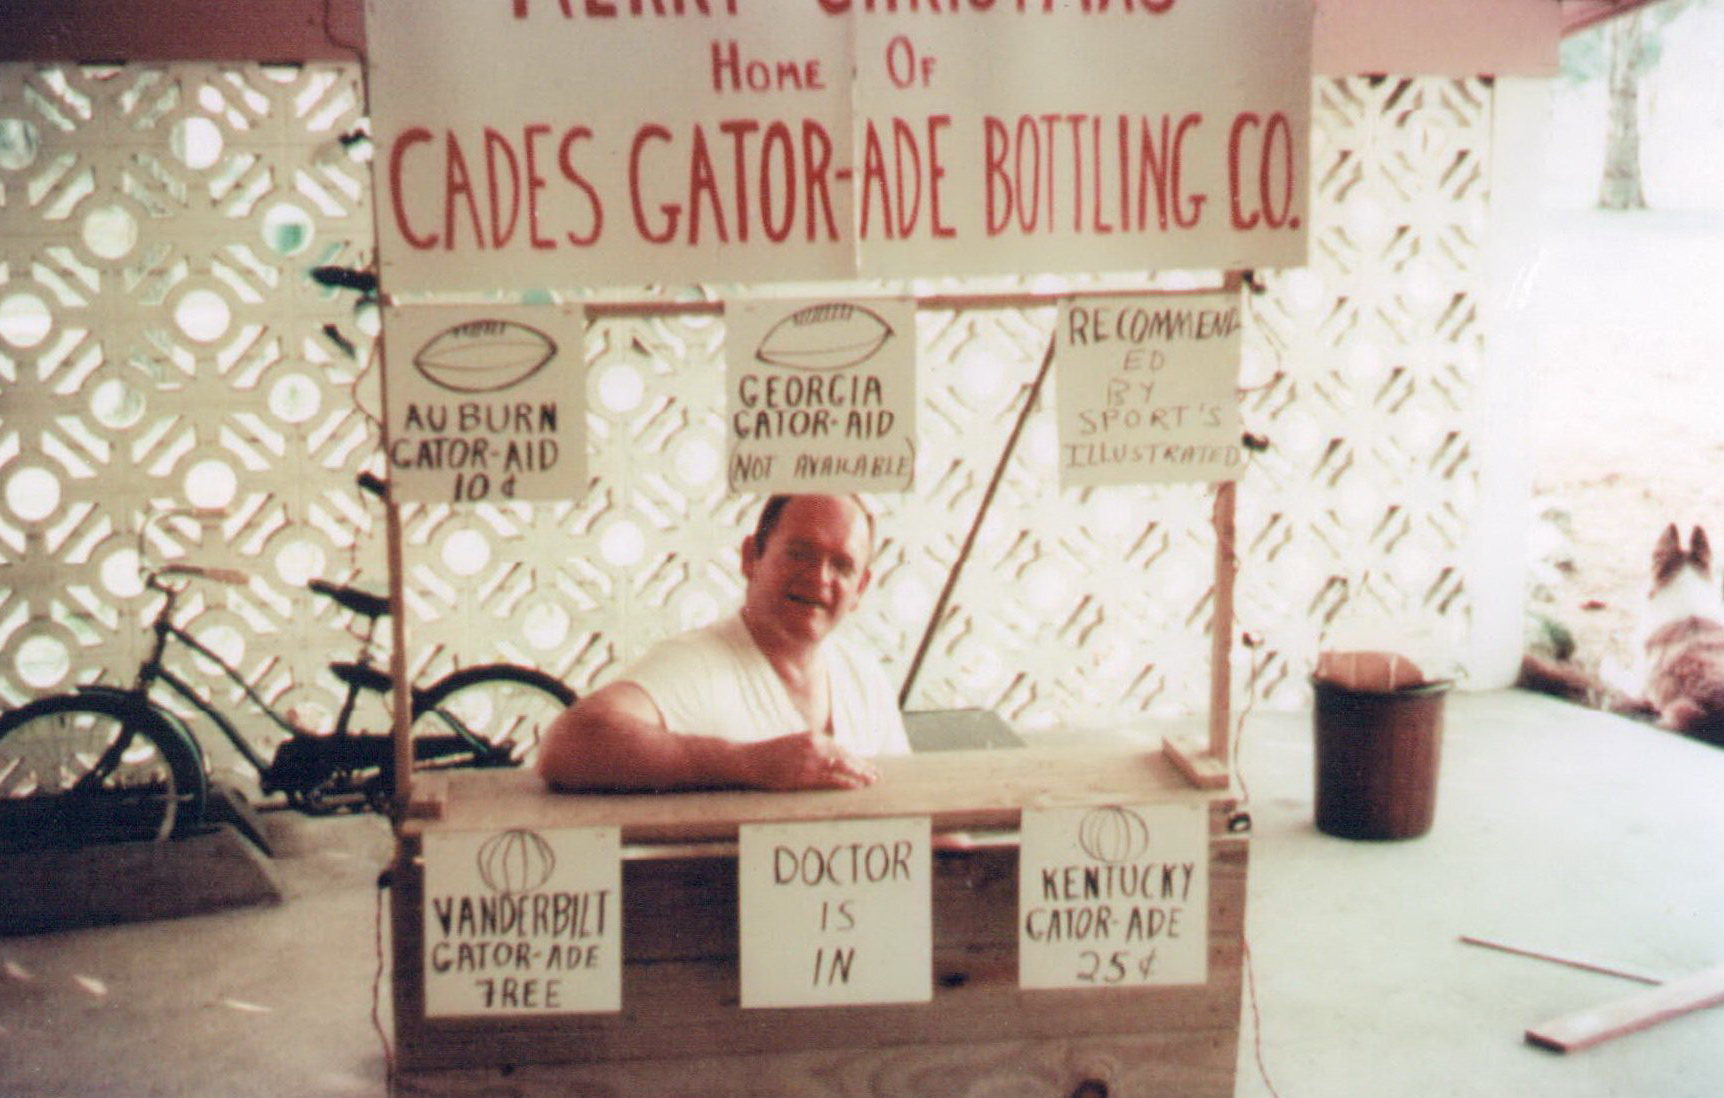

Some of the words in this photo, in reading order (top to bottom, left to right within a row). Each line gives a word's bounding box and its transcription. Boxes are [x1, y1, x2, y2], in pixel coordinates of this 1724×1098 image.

[389, 123, 604, 251] CADES
[628, 111, 957, 247] GATOR-ADE
[983, 112, 1207, 238] BOTTLING
[1228, 111, 1301, 231] CO.
[1122, 348, 1165, 372] ED
[739, 374, 883, 409] GEORGIA
[1106, 377, 1155, 407] BY
[404, 403, 558, 433] AUBURN
[1063, 442, 1242, 468] ILLUSTRATED
[773, 840, 913, 886] DOCTOR
[1042, 862, 1195, 901] KENTUCKY
[432, 890, 610, 939] VANDERBILT
[821, 901, 855, 932] IS
[1025, 906, 1183, 942] GATOR-ADE
[432, 941, 600, 974] GATOR-ADE
[812, 947, 856, 987] IN
